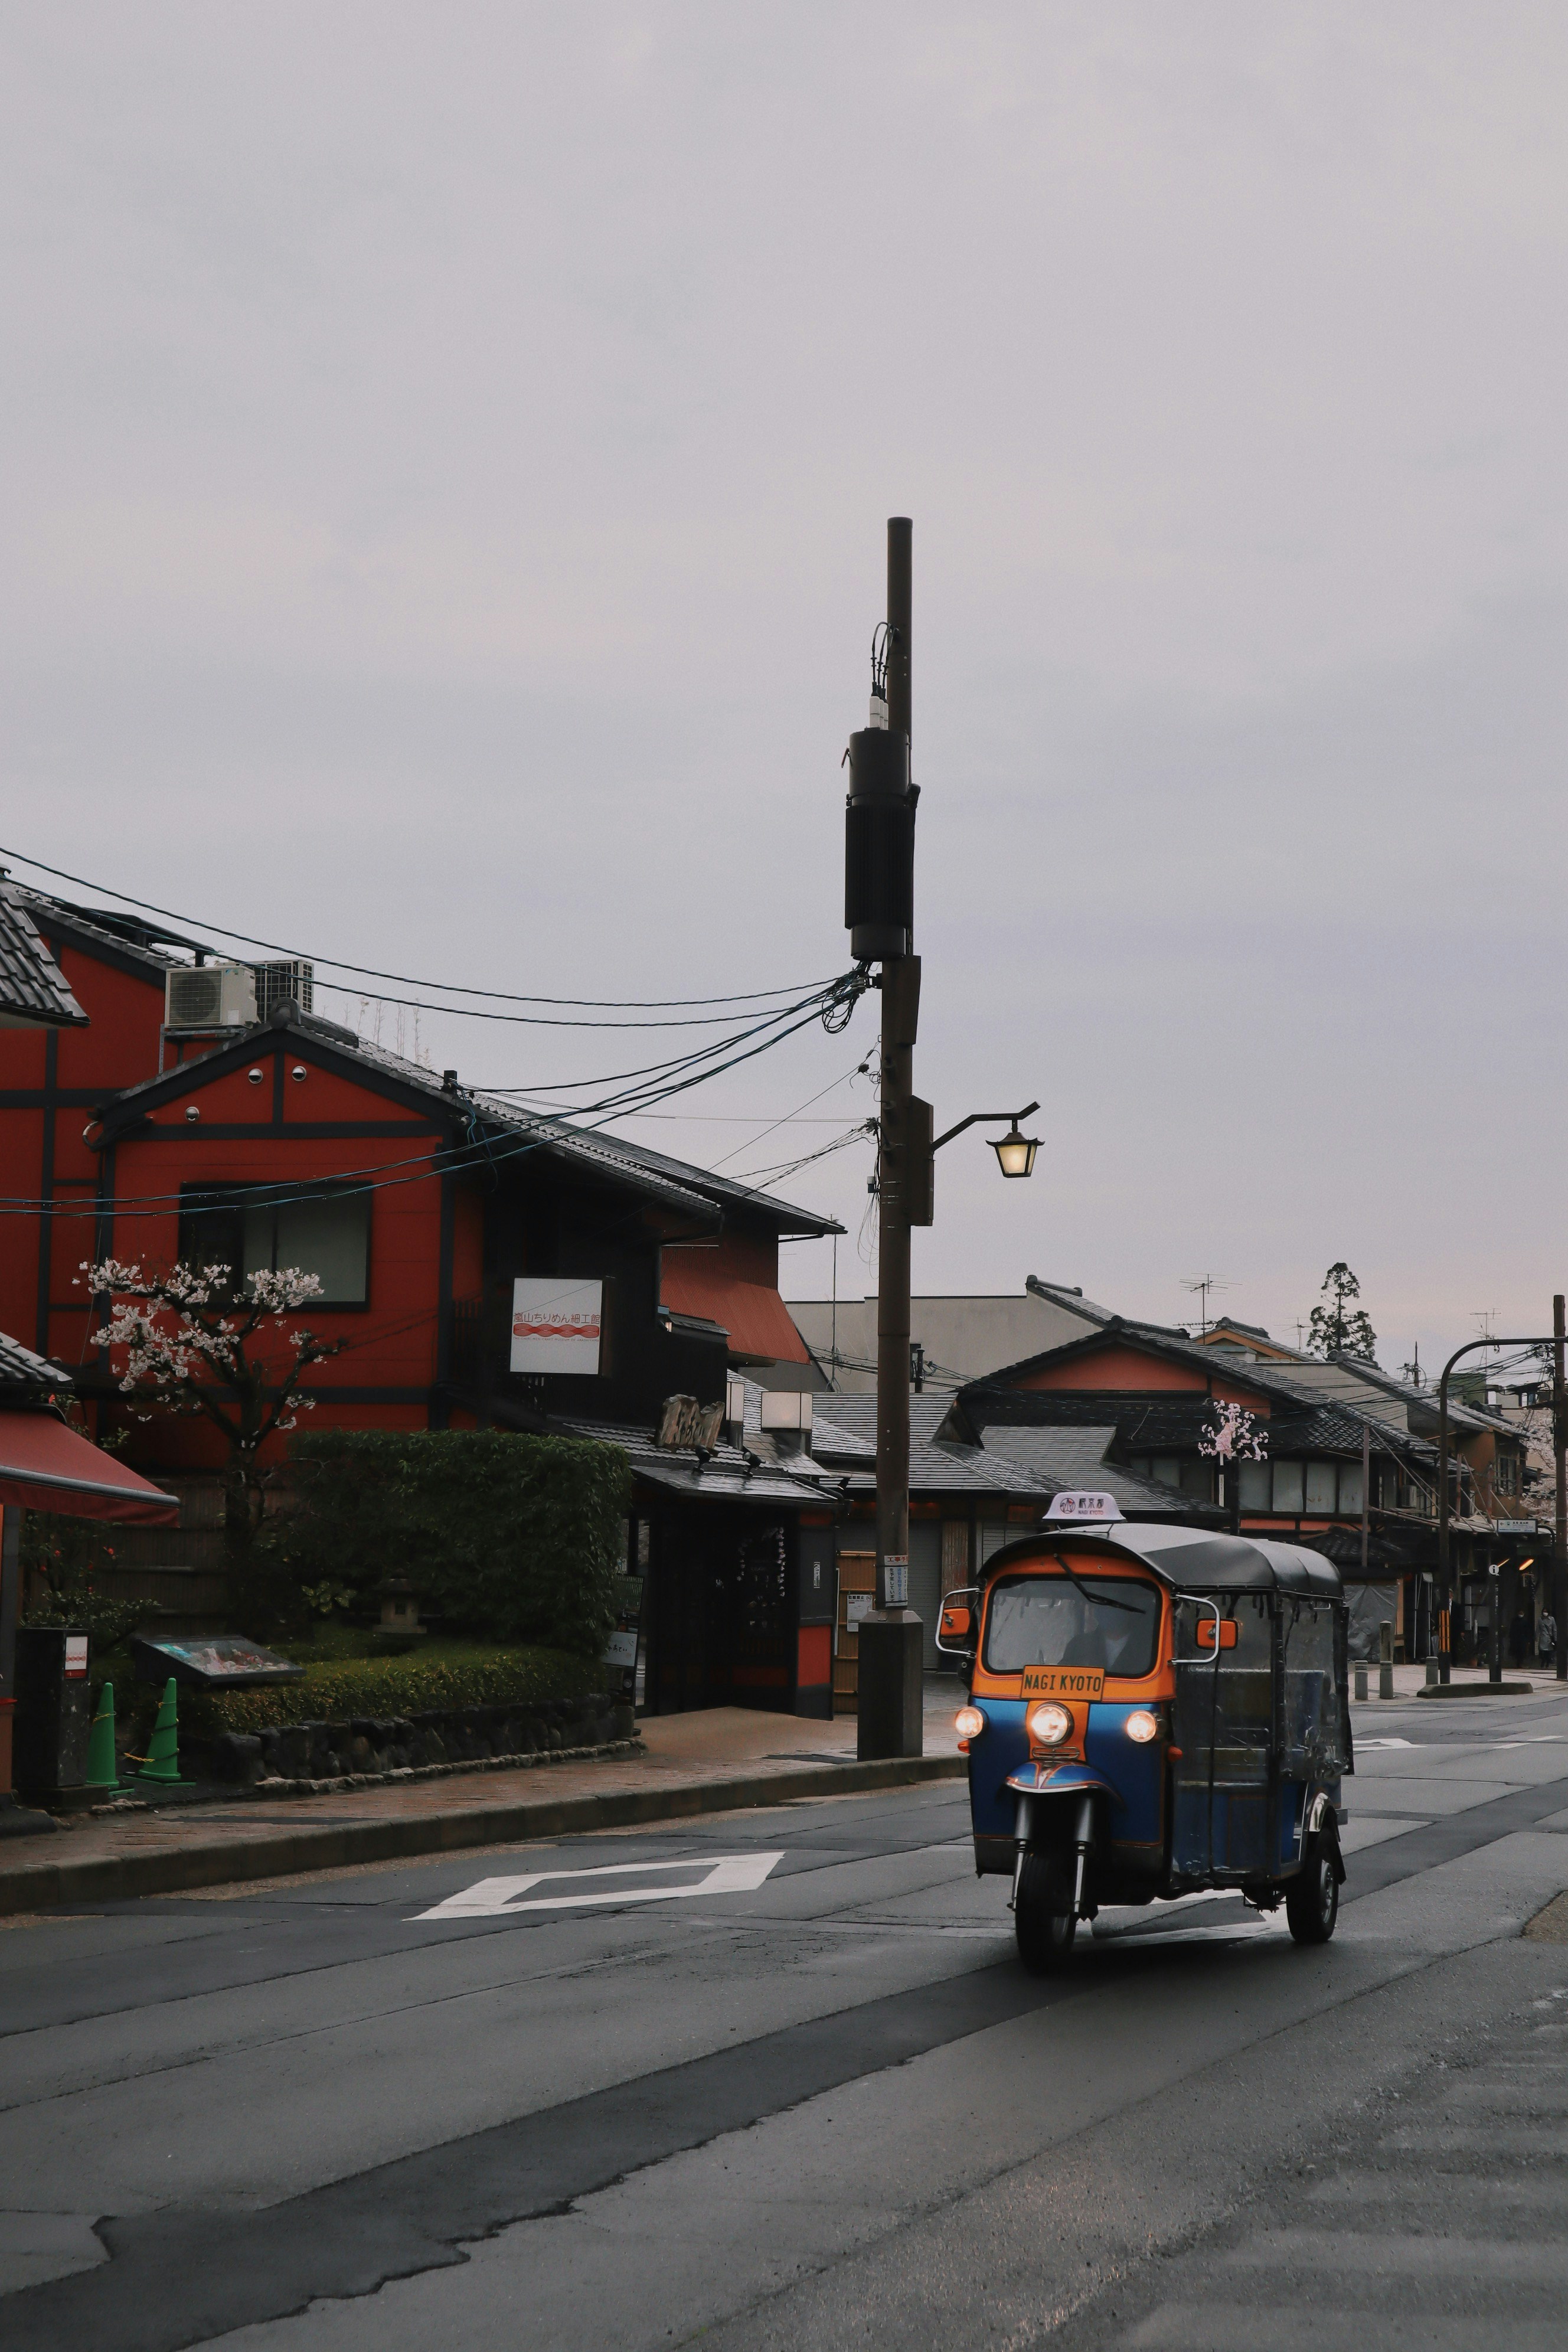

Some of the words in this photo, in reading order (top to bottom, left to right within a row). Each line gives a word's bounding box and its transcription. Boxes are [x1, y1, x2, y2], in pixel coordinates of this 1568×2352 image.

[514, 1313, 600, 1324] 嵐山ちりめん細工館
[1024, 1674, 1056, 1690] NAGI
[1060, 1675, 1102, 1692] KYOTO
